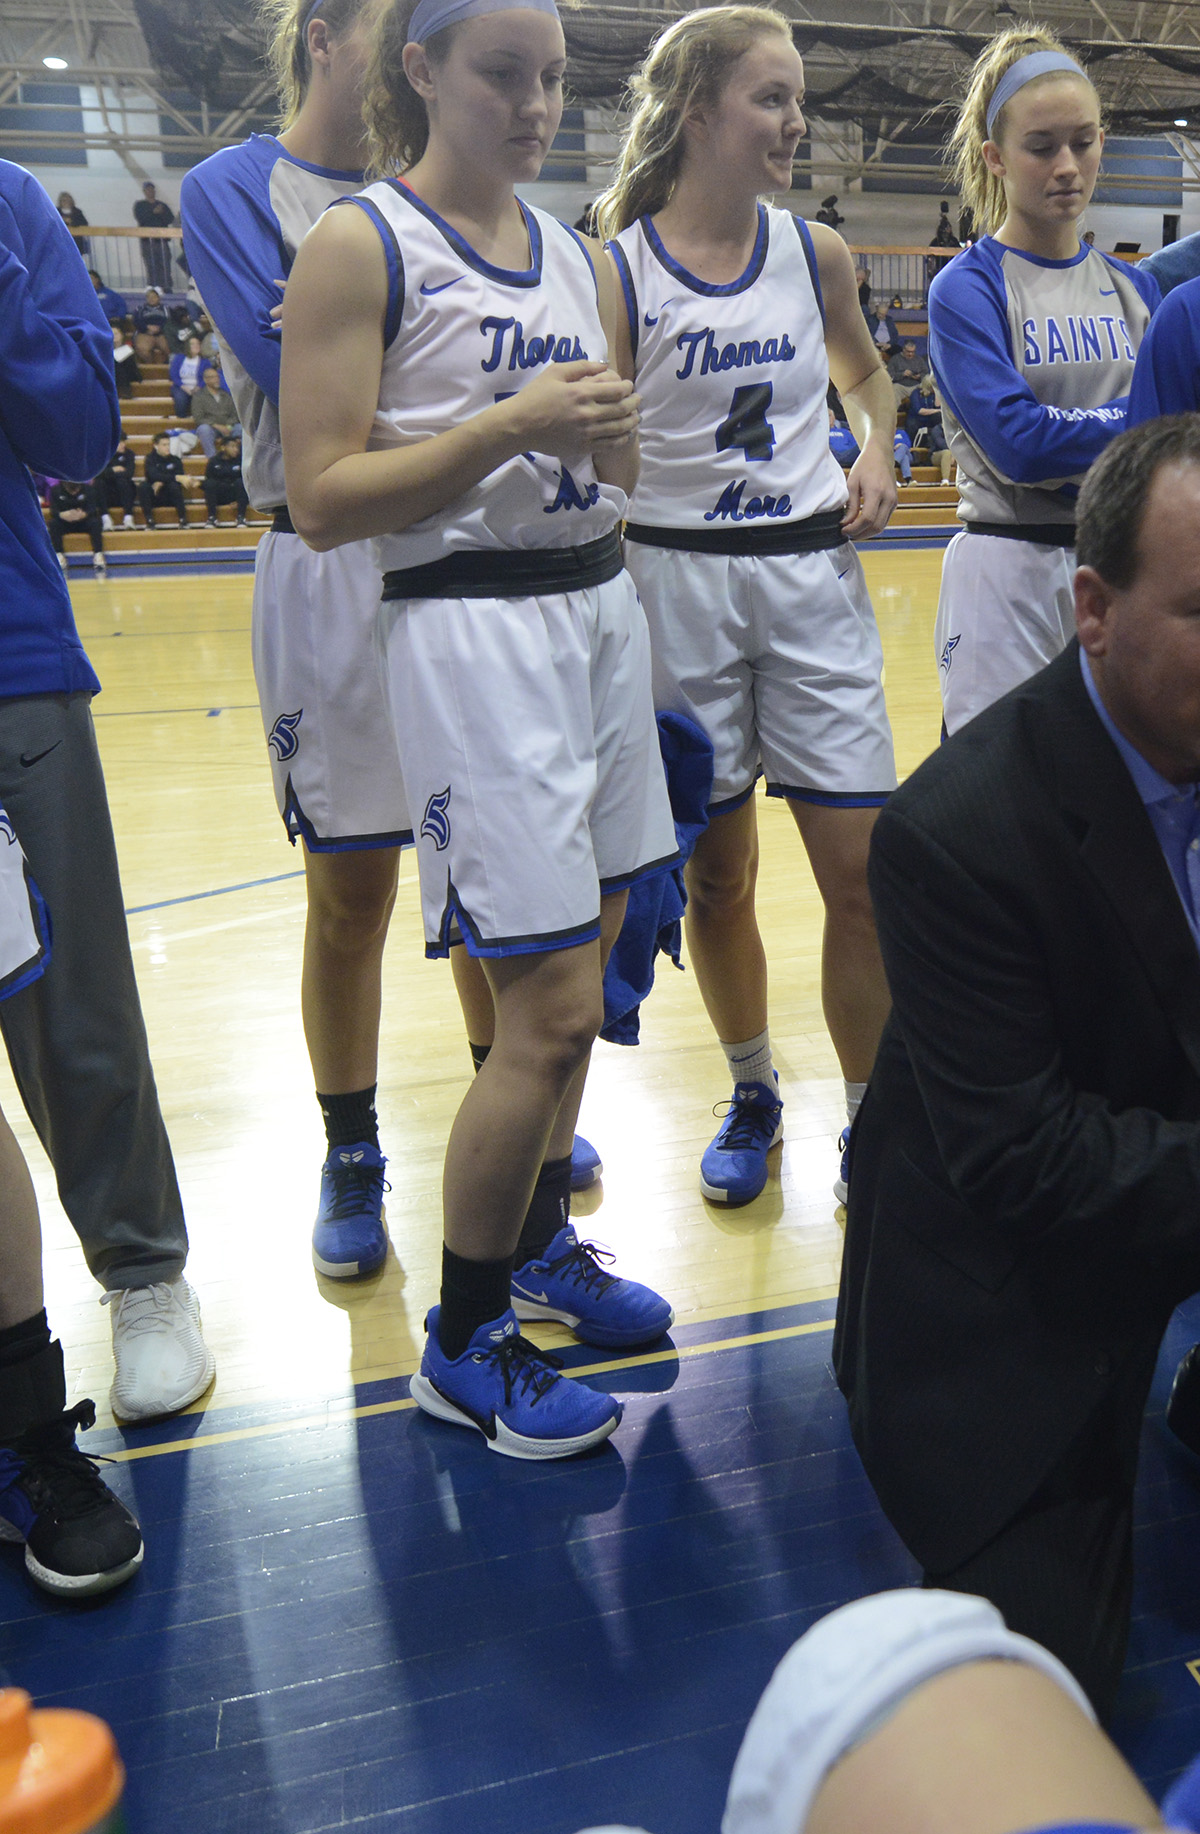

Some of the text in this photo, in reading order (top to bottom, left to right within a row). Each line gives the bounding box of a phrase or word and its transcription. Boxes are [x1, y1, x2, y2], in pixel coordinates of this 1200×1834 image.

[675, 326, 796, 380] Thomas
[714, 380, 777, 463] 4
[703, 479, 793, 522] More
